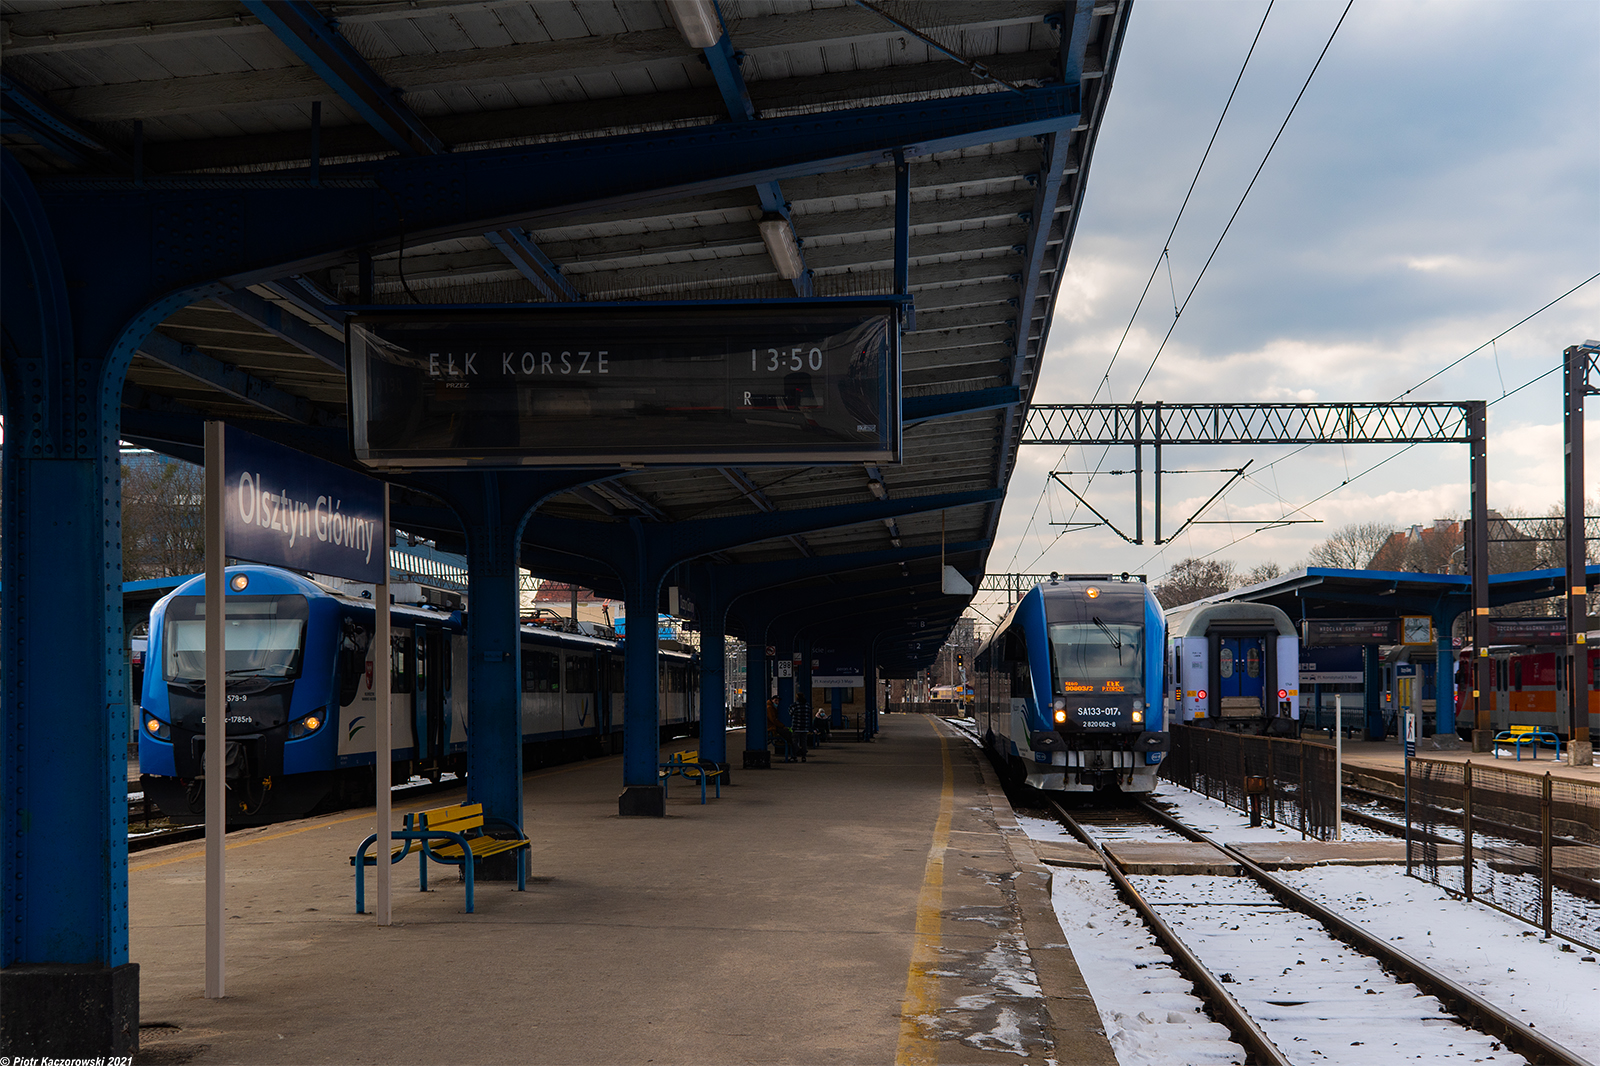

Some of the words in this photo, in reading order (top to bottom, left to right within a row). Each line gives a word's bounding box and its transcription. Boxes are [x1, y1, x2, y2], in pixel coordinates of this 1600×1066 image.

[429, 351, 478, 376] EŁK
[502, 350, 609, 375] KORSZE
[752, 347, 822, 372] 13:50
[743, 391, 752, 406] R
[238, 471, 310, 548] Olsztyn
[314, 495, 374, 565] Główny
